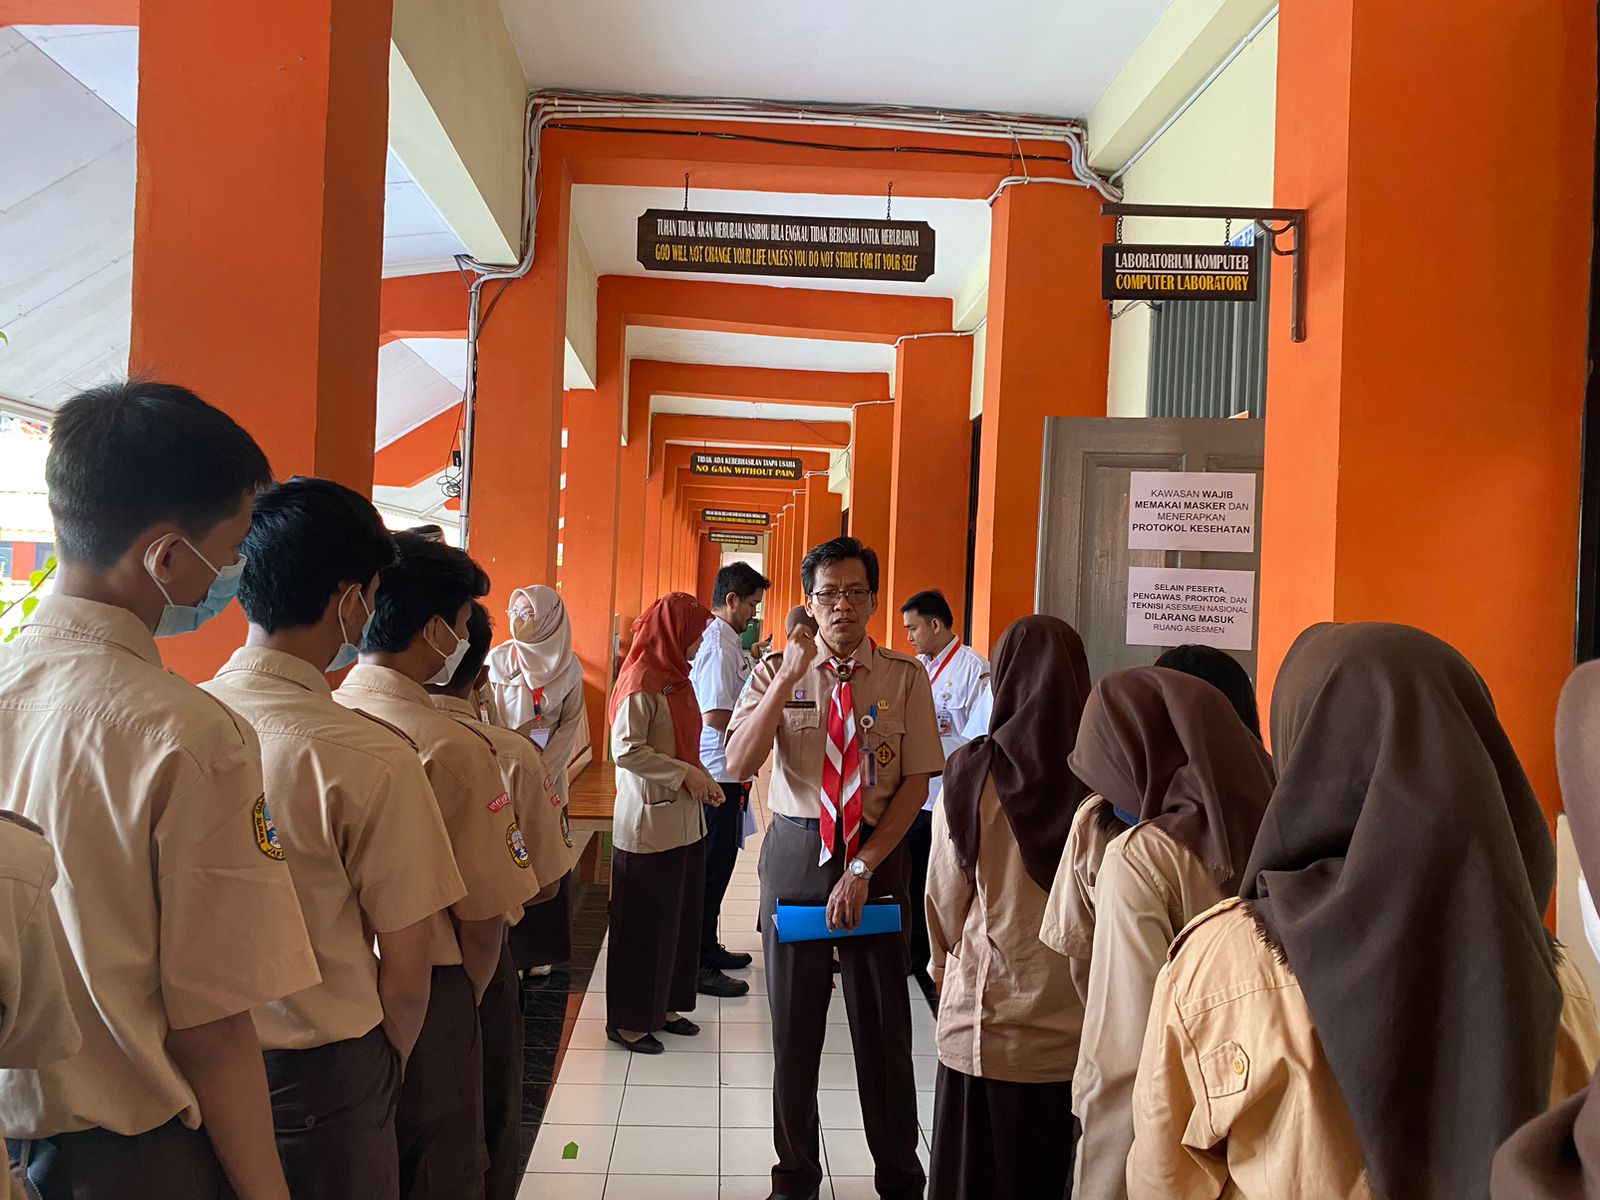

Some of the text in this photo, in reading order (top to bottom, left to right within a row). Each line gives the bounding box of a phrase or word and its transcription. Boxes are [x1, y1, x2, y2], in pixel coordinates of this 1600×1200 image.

[657, 219, 919, 246] TUHAN TIDAK AKAN MERUBAH NASIBMU BILA ENGKAU TIDAK BERUSAHA UNTUK MERUBAHNYA
[655, 244, 918, 271] GOD WILL NOT CHANGE YOUR LIFE UNLESS YOU DO NOT STRIVE FOR IT YOUR SELF
[1115, 253, 1249, 270] LABORATORIUM KOMPUTER
[1116, 274, 1249, 291] COMPUTER LABORATORY
[697, 455, 796, 468] TIDAK ADA KEBERHASILAN TANPA USAHA
[696, 464, 795, 477] NO GAIN WITHOUT PAIN
[1151, 489, 1233, 499] KAWASAN WAJIB
[1135, 501, 1249, 510] MEMAKAI MASKER DAN
[1157, 512, 1226, 521] MENERAPKAN
[1132, 524, 1250, 534] PROTOKOL KESEHATAN
[1154, 584, 1184, 592] SELAIN
[1230, 596, 1247, 604] DAN
[1131, 602, 1248, 614] TEKNISI ASESMEN NASIONAL
[1144, 612, 1234, 624] DILARANG MASUK
[1153, 624, 1224, 633] RUANG ASESMEN
